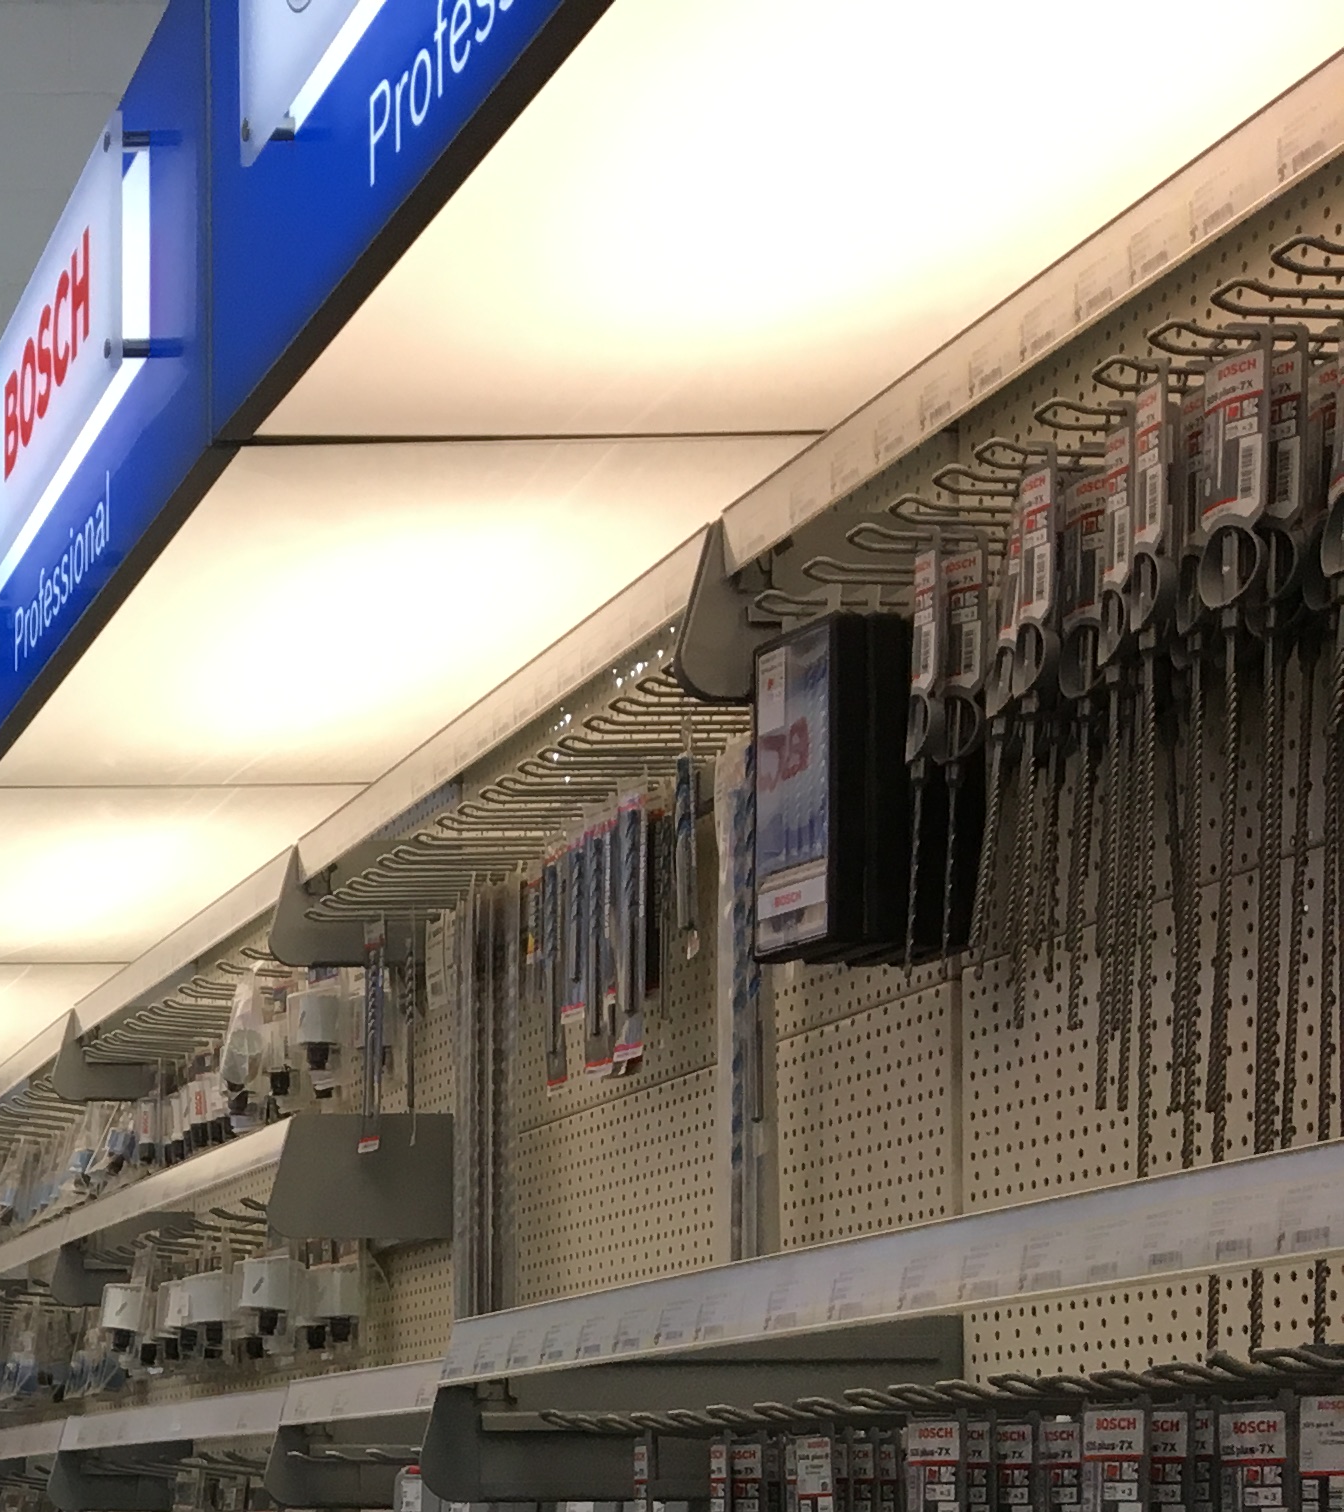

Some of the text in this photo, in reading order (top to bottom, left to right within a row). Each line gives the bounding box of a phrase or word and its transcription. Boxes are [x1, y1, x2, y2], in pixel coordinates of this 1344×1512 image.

[369, 0, 512, 188] Profes
[4, 225, 90, 482] BOSCH
[1218, 358, 1257, 380] BOSCH
[1272, 361, 1294, 376] SCH
[14, 469, 110, 671] Professional
[1095, 1417, 1137, 1431] BOSCH
[1151, 1420, 1180, 1432] SCH
[1233, 1420, 1278, 1434] BOSCH
[967, 1430, 985, 1440] SCH
